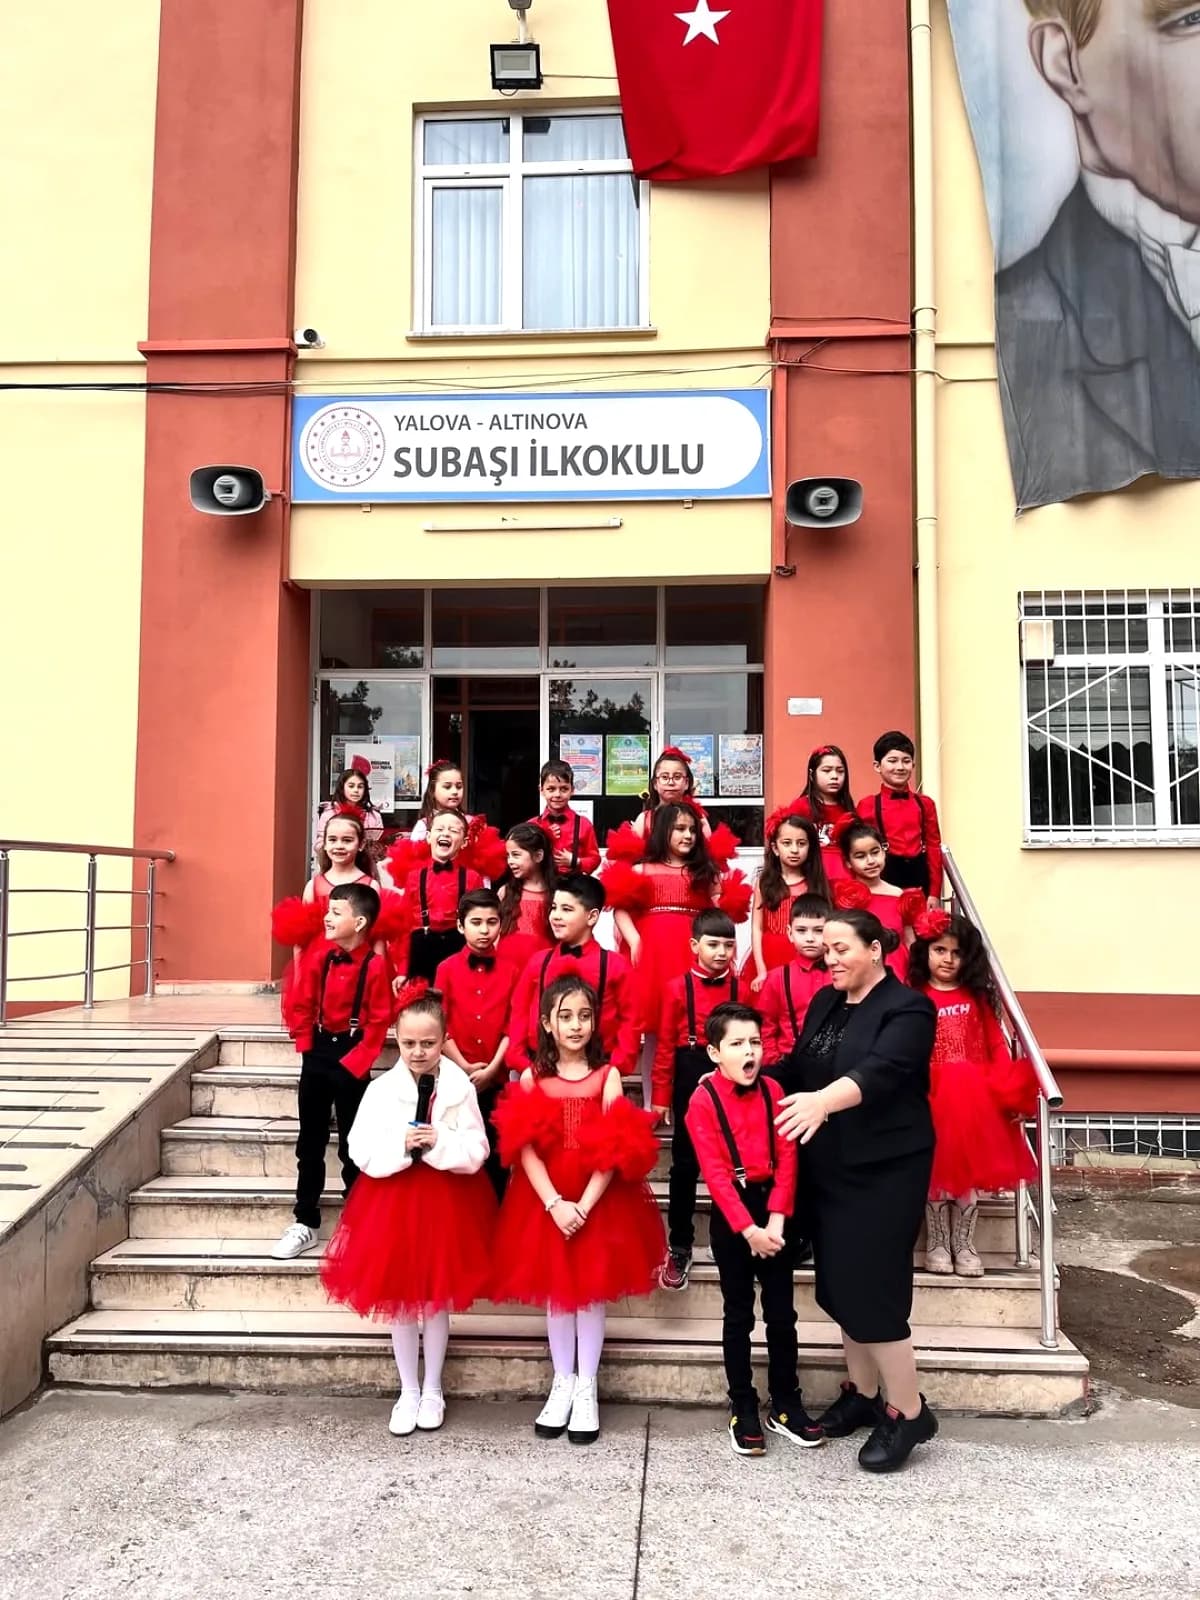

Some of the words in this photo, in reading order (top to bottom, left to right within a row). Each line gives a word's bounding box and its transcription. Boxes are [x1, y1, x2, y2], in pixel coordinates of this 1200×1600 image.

[393, 414, 472, 431] YALOVA
[489, 413, 588, 430] ALTINOVA
[393, 446, 518, 486] SUBAŞI
[530, 438, 704, 476] İLKOKULU
[937, 1003, 971, 1017] ATCH
